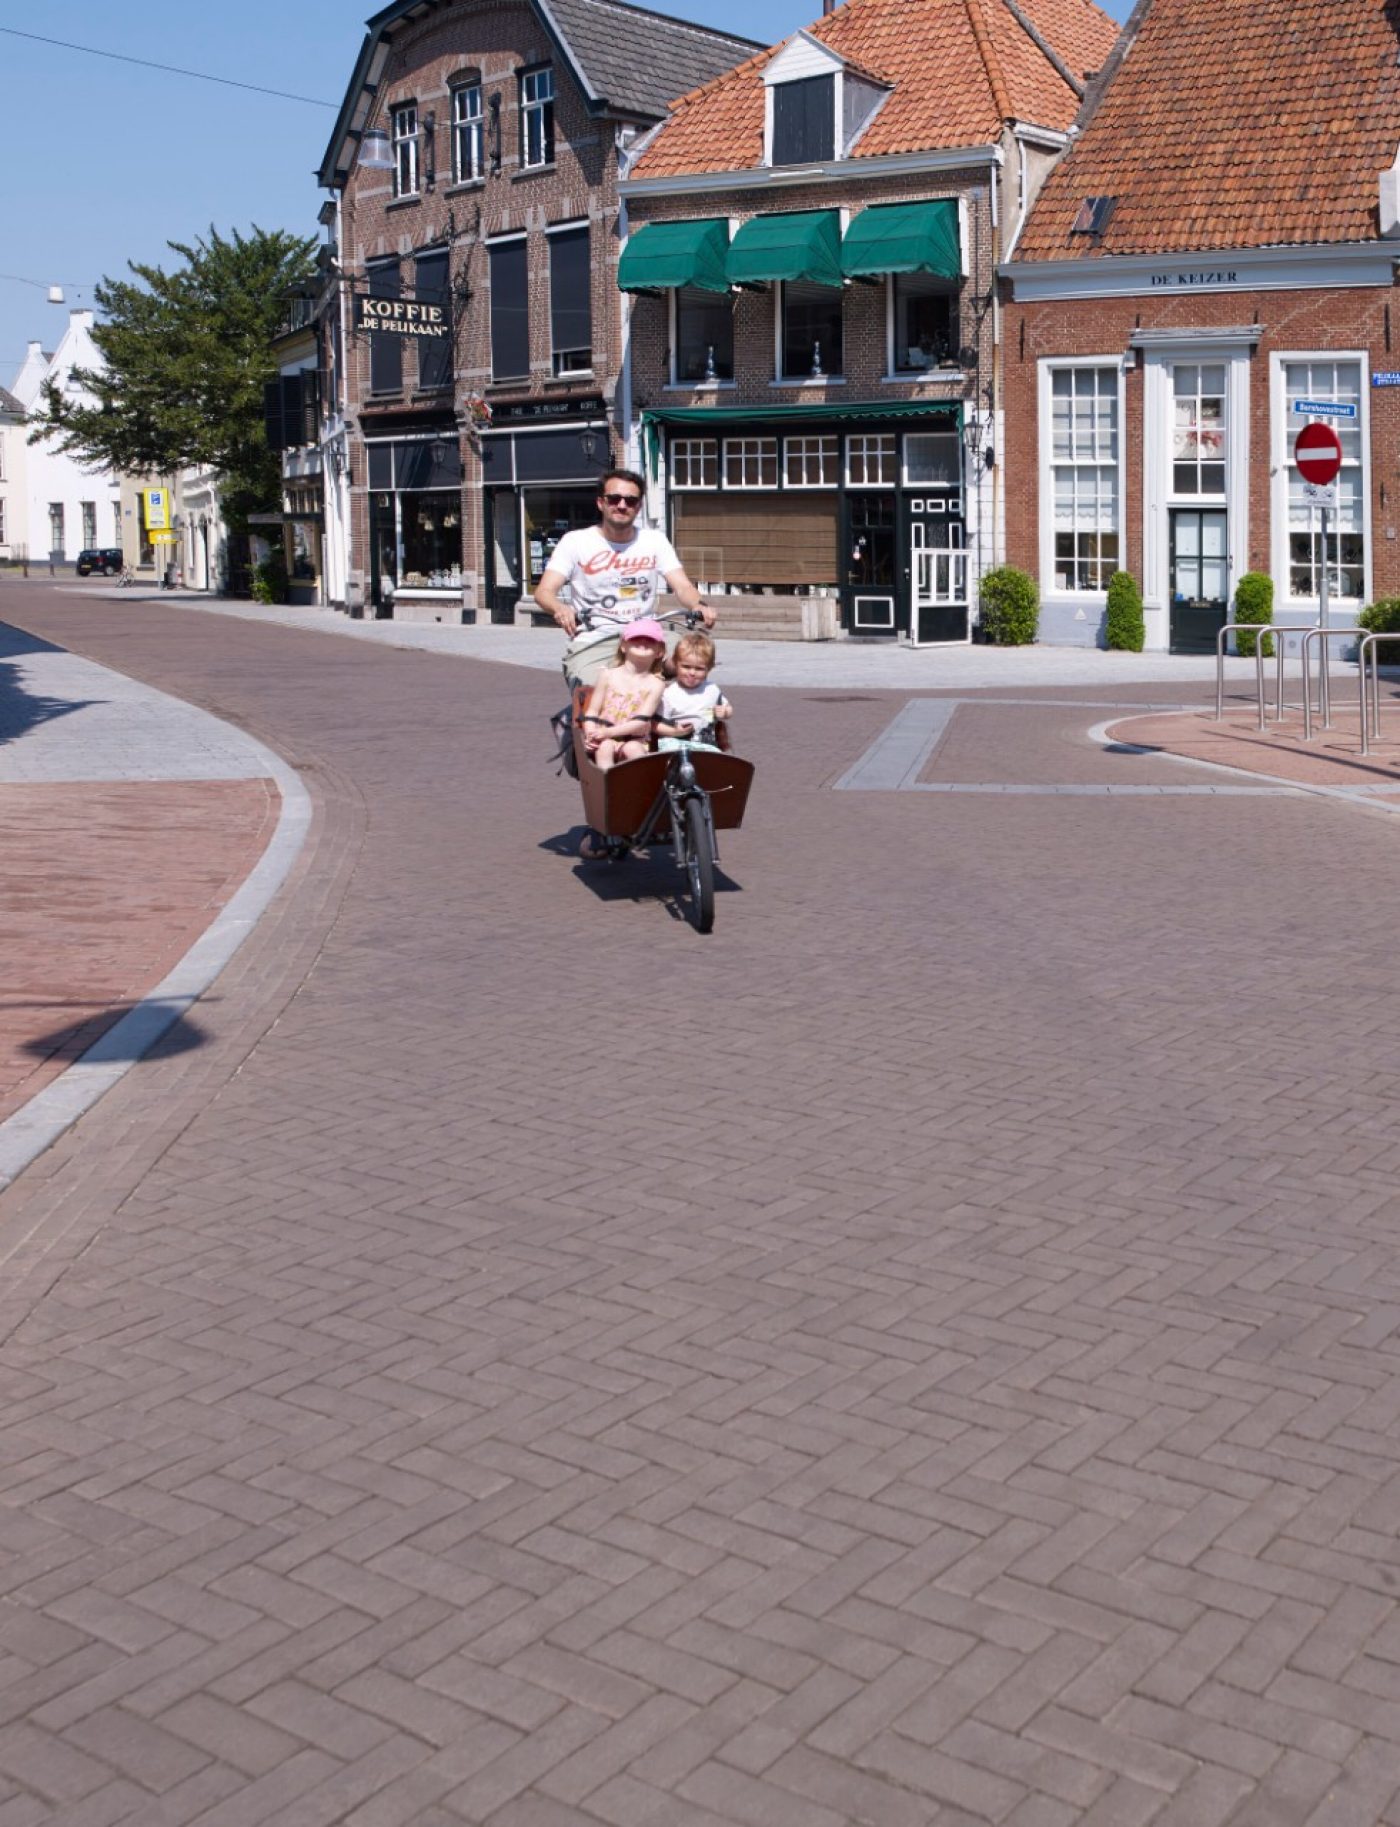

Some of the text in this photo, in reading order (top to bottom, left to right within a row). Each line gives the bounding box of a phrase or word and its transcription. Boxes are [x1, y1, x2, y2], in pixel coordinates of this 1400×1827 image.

[1151, 271, 1237, 286] DE KEIZER
[362, 299, 442, 322] KOFFIE
